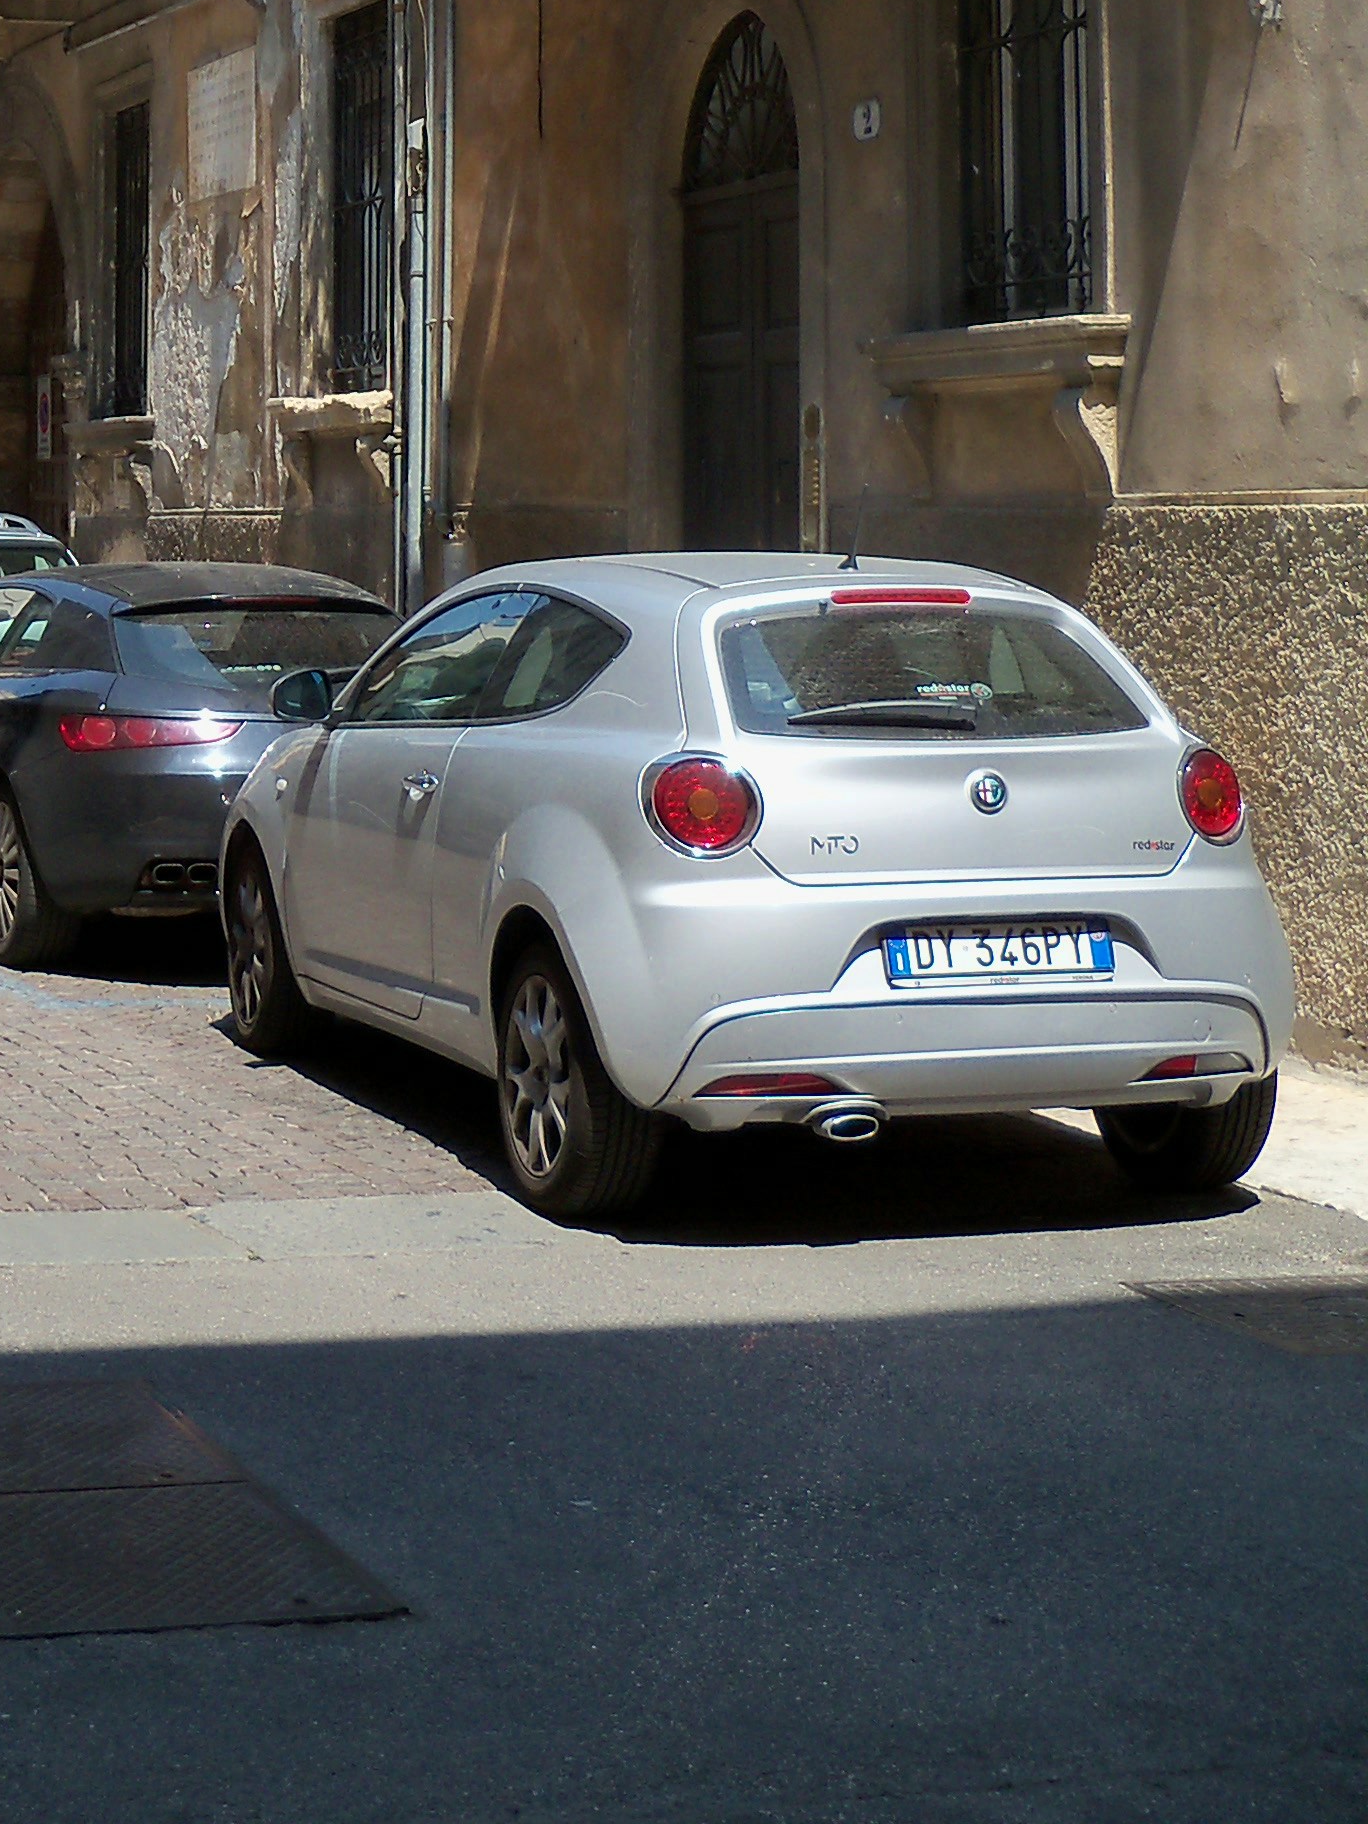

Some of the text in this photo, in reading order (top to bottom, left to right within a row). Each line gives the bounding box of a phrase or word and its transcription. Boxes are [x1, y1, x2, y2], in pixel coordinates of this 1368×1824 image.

[862, 103, 873, 135] 2
[911, 928, 955, 970] DY
[971, 925, 1082, 967] 346PY
